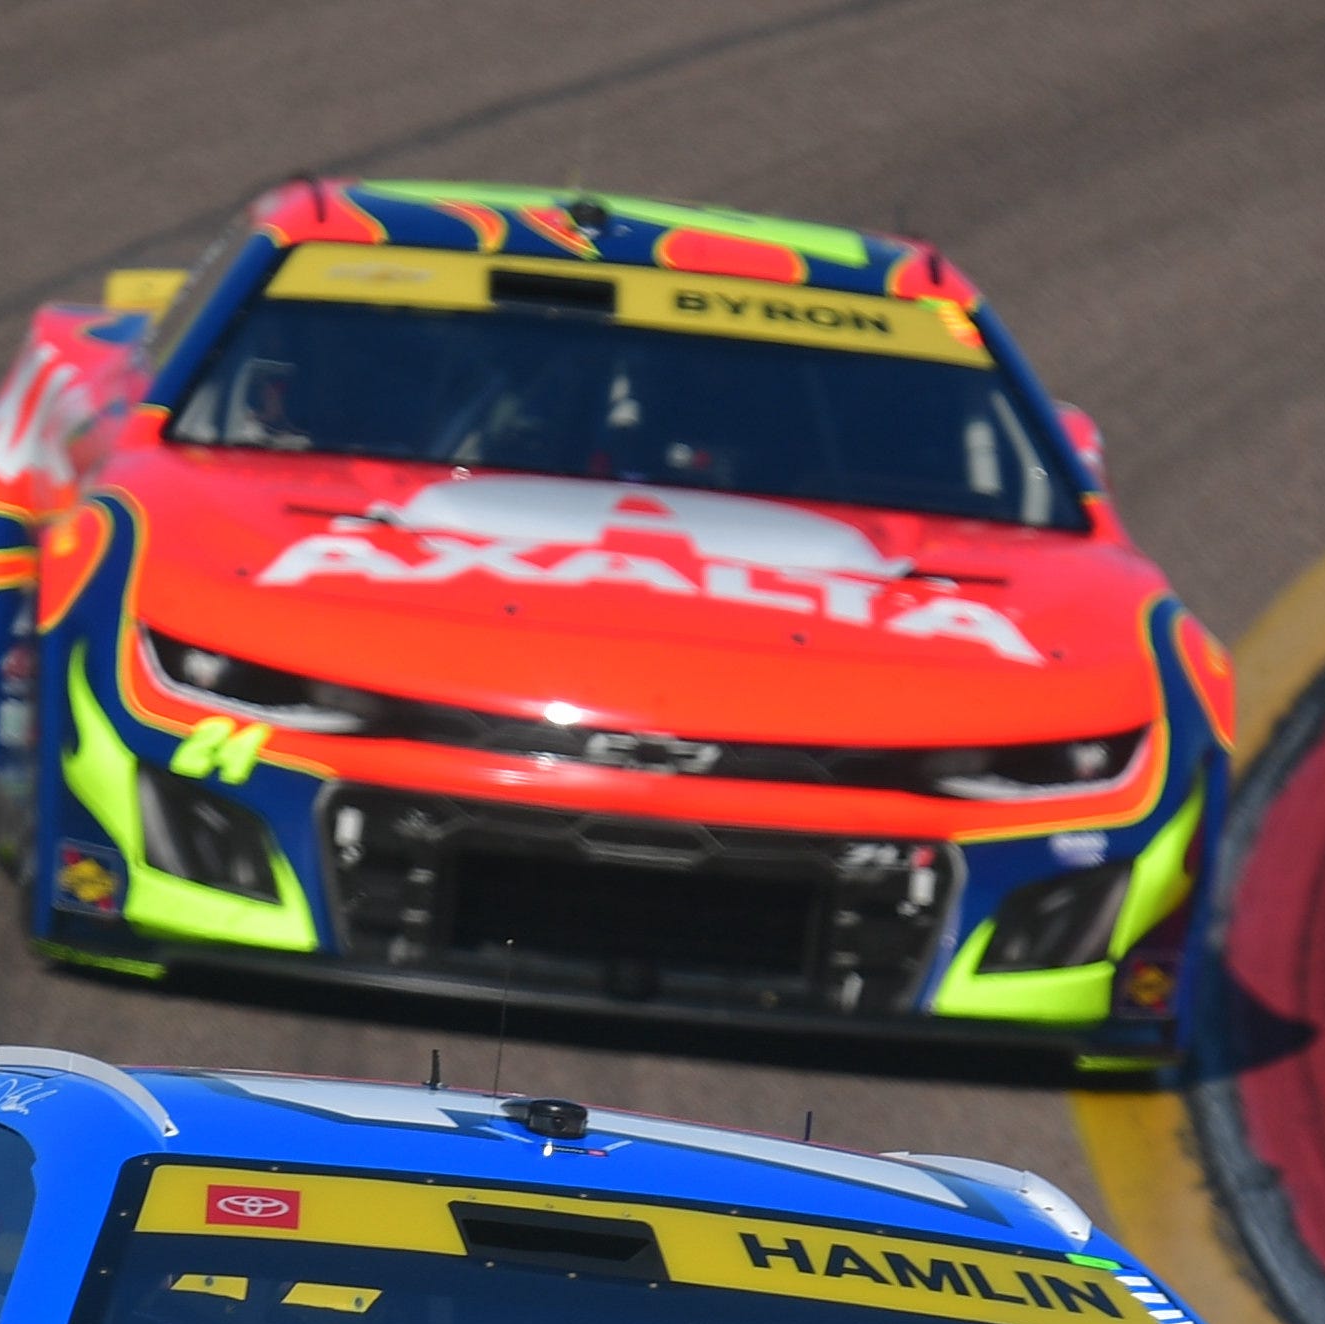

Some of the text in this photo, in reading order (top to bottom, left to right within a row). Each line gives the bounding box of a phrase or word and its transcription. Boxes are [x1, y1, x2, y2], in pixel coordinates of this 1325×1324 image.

[674, 290, 891, 335] BYRON
[256, 532, 1046, 667] AXALTA
[738, 1232, 1125, 1320] HAMLIN
